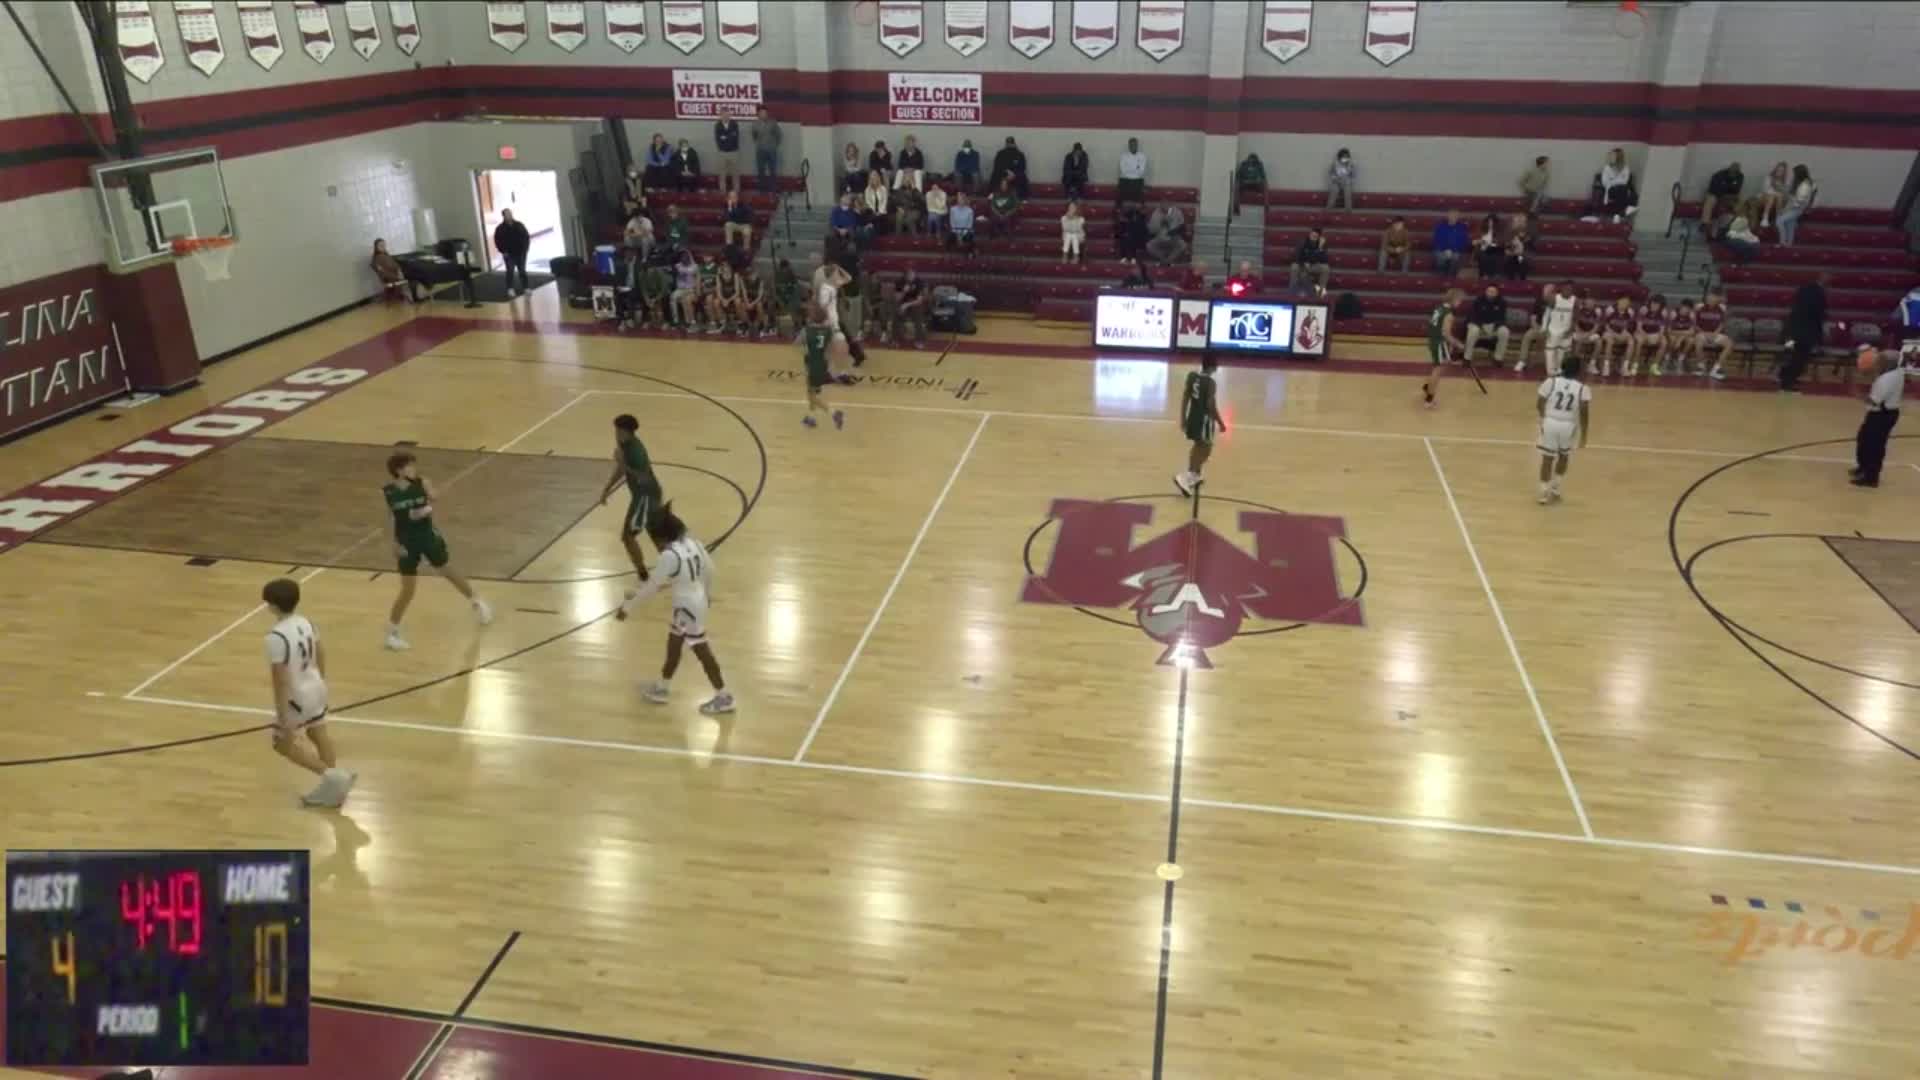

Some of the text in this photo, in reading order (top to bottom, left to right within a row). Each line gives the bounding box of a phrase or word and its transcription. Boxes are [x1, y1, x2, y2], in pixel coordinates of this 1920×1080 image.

[676, 82, 760, 99] WELCOME
[892, 87, 979, 105] WELCOME
[681, 102, 713, 115] GUEST
[896, 106, 976, 121] GUEST SECTION
[1178, 311, 1208, 337] M
[1554, 391, 1575, 411] 22
[0, 365, 369, 547] RRIORS
